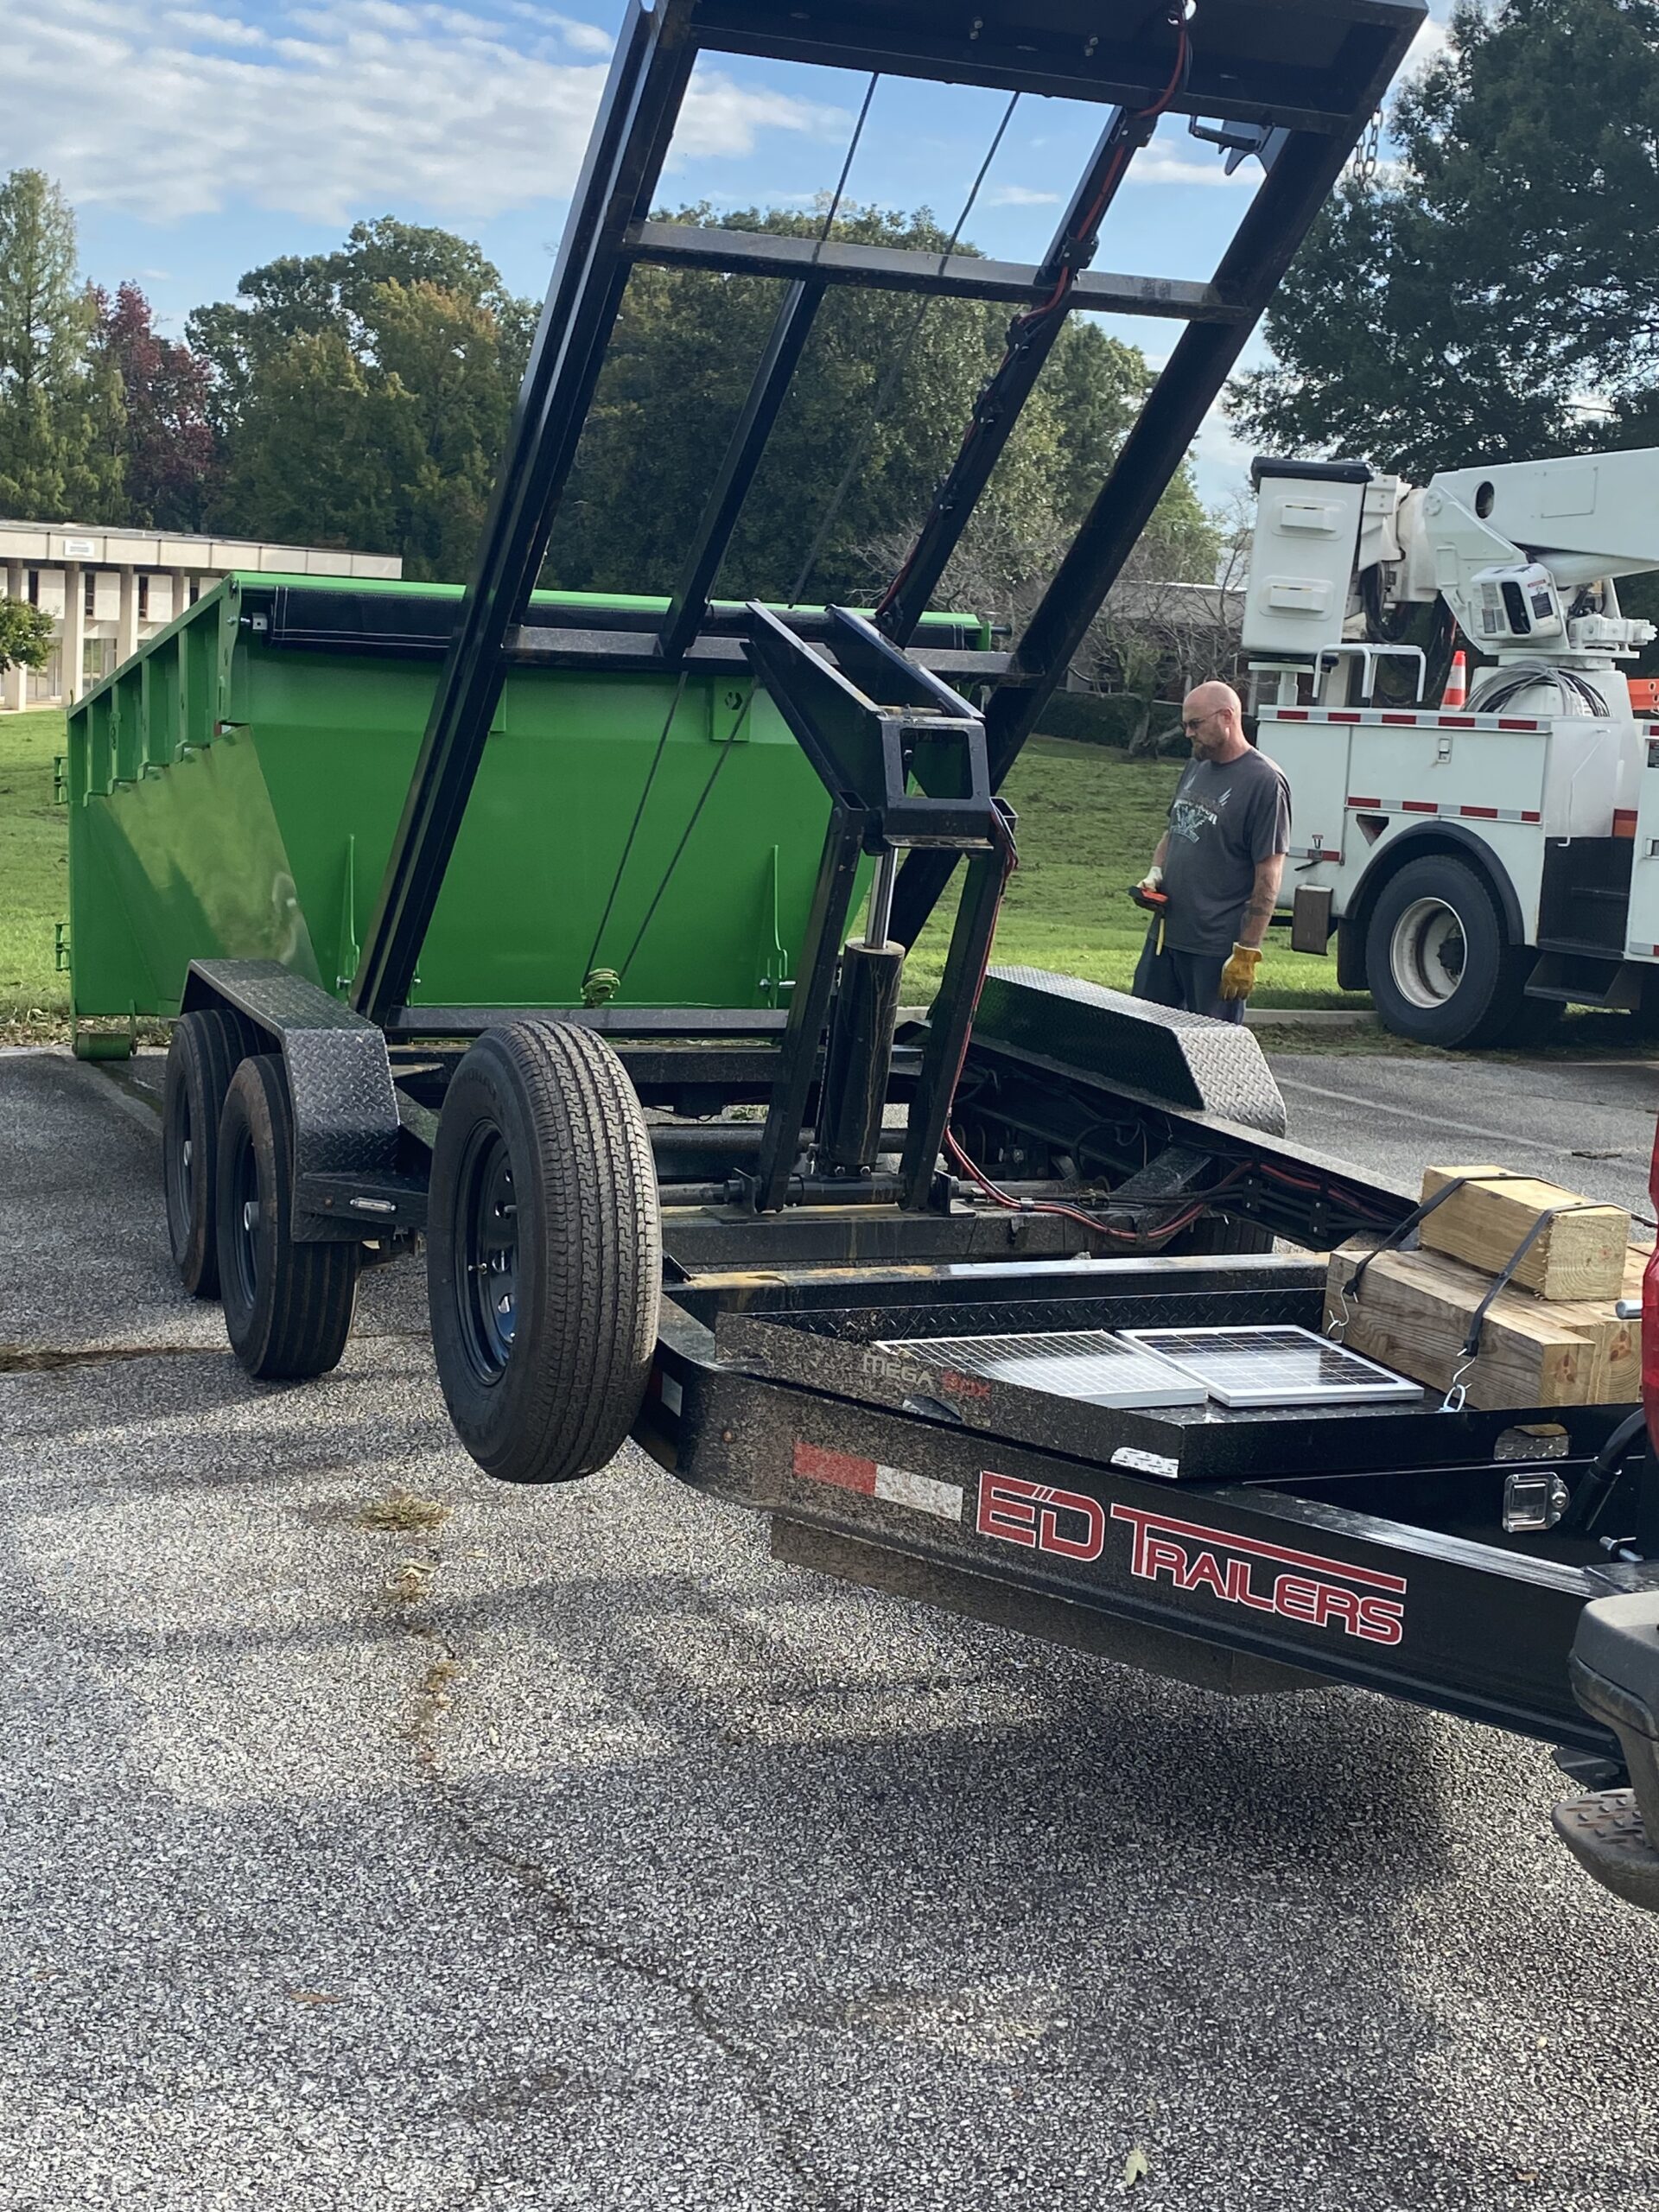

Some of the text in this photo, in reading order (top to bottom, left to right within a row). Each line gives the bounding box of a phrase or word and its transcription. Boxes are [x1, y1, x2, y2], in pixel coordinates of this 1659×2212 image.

[863, 1353, 936, 1387] MEGA
[976, 1470, 1408, 1646] ED TRAILERS
